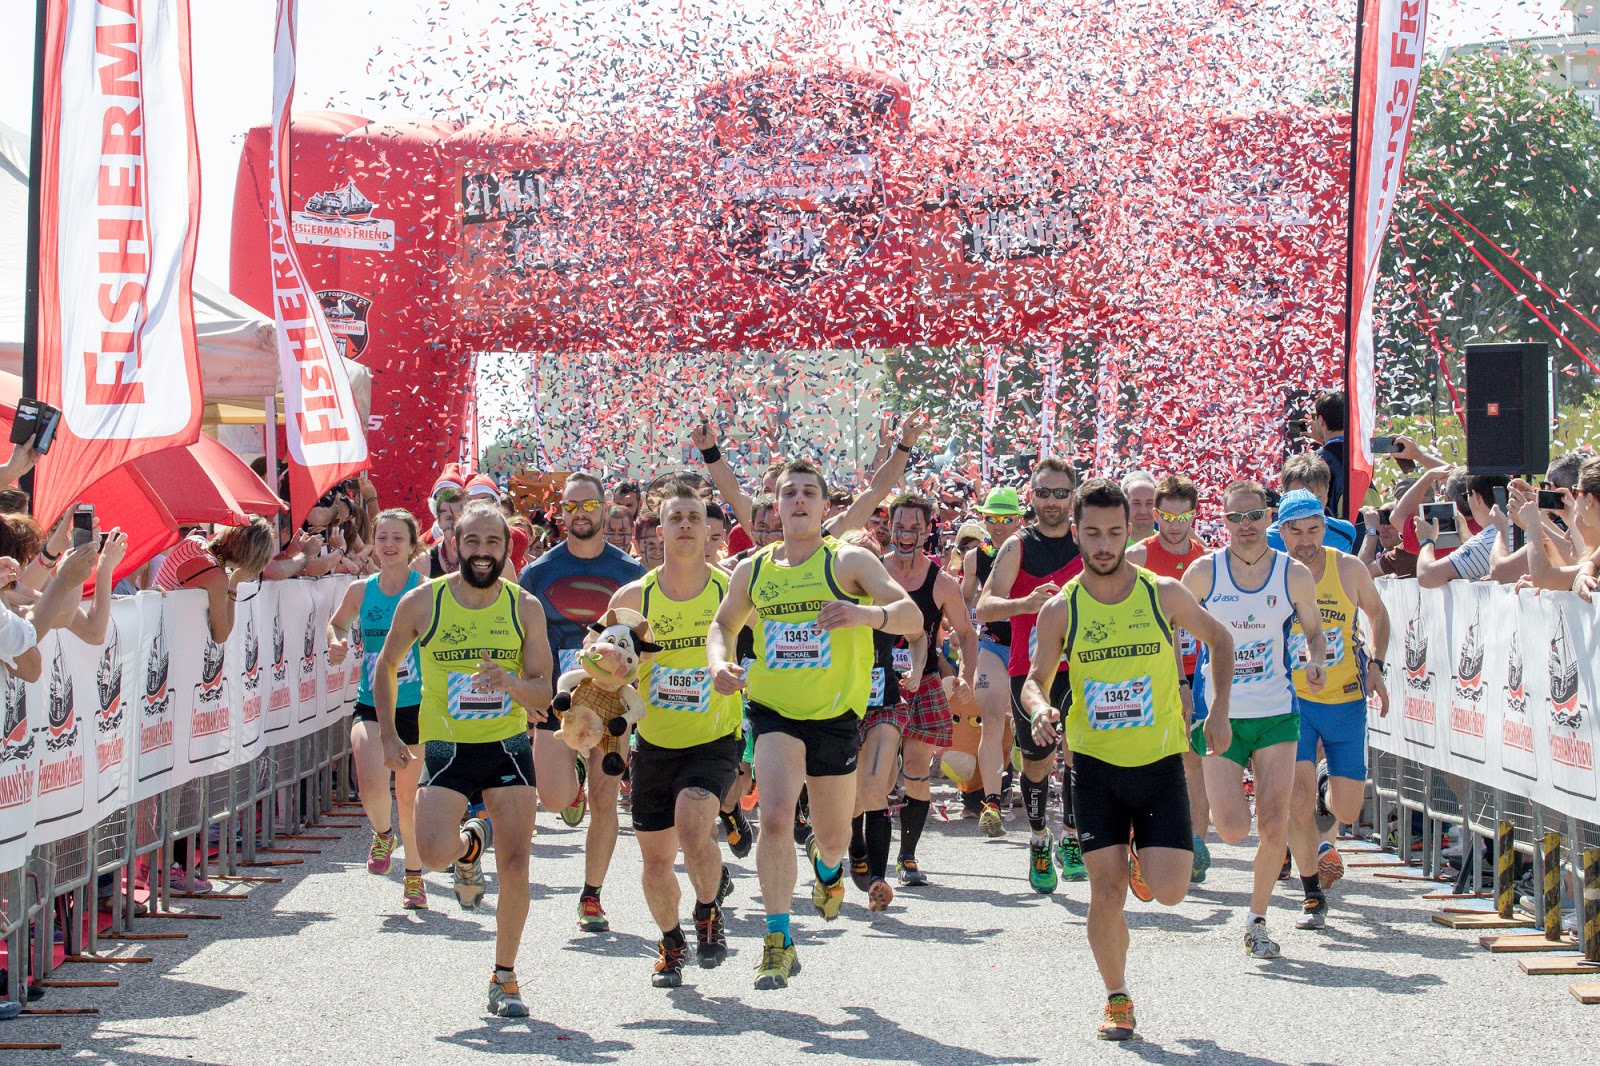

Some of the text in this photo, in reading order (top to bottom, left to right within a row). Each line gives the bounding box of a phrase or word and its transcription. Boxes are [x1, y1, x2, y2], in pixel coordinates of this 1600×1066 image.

[353, 226, 390, 241] FRIEND
[781, 603, 802, 614] HOT
[805, 601, 823, 611] DO
[784, 630, 809, 642] 1343
[676, 637, 697, 648] HOT
[435, 649, 466, 660] FURY
[497, 650, 516, 659] DOG
[1081, 643, 1158, 661] FURY HOT DOG
[668, 675, 691, 687] 1636
[1104, 690, 1130, 702] 1342
